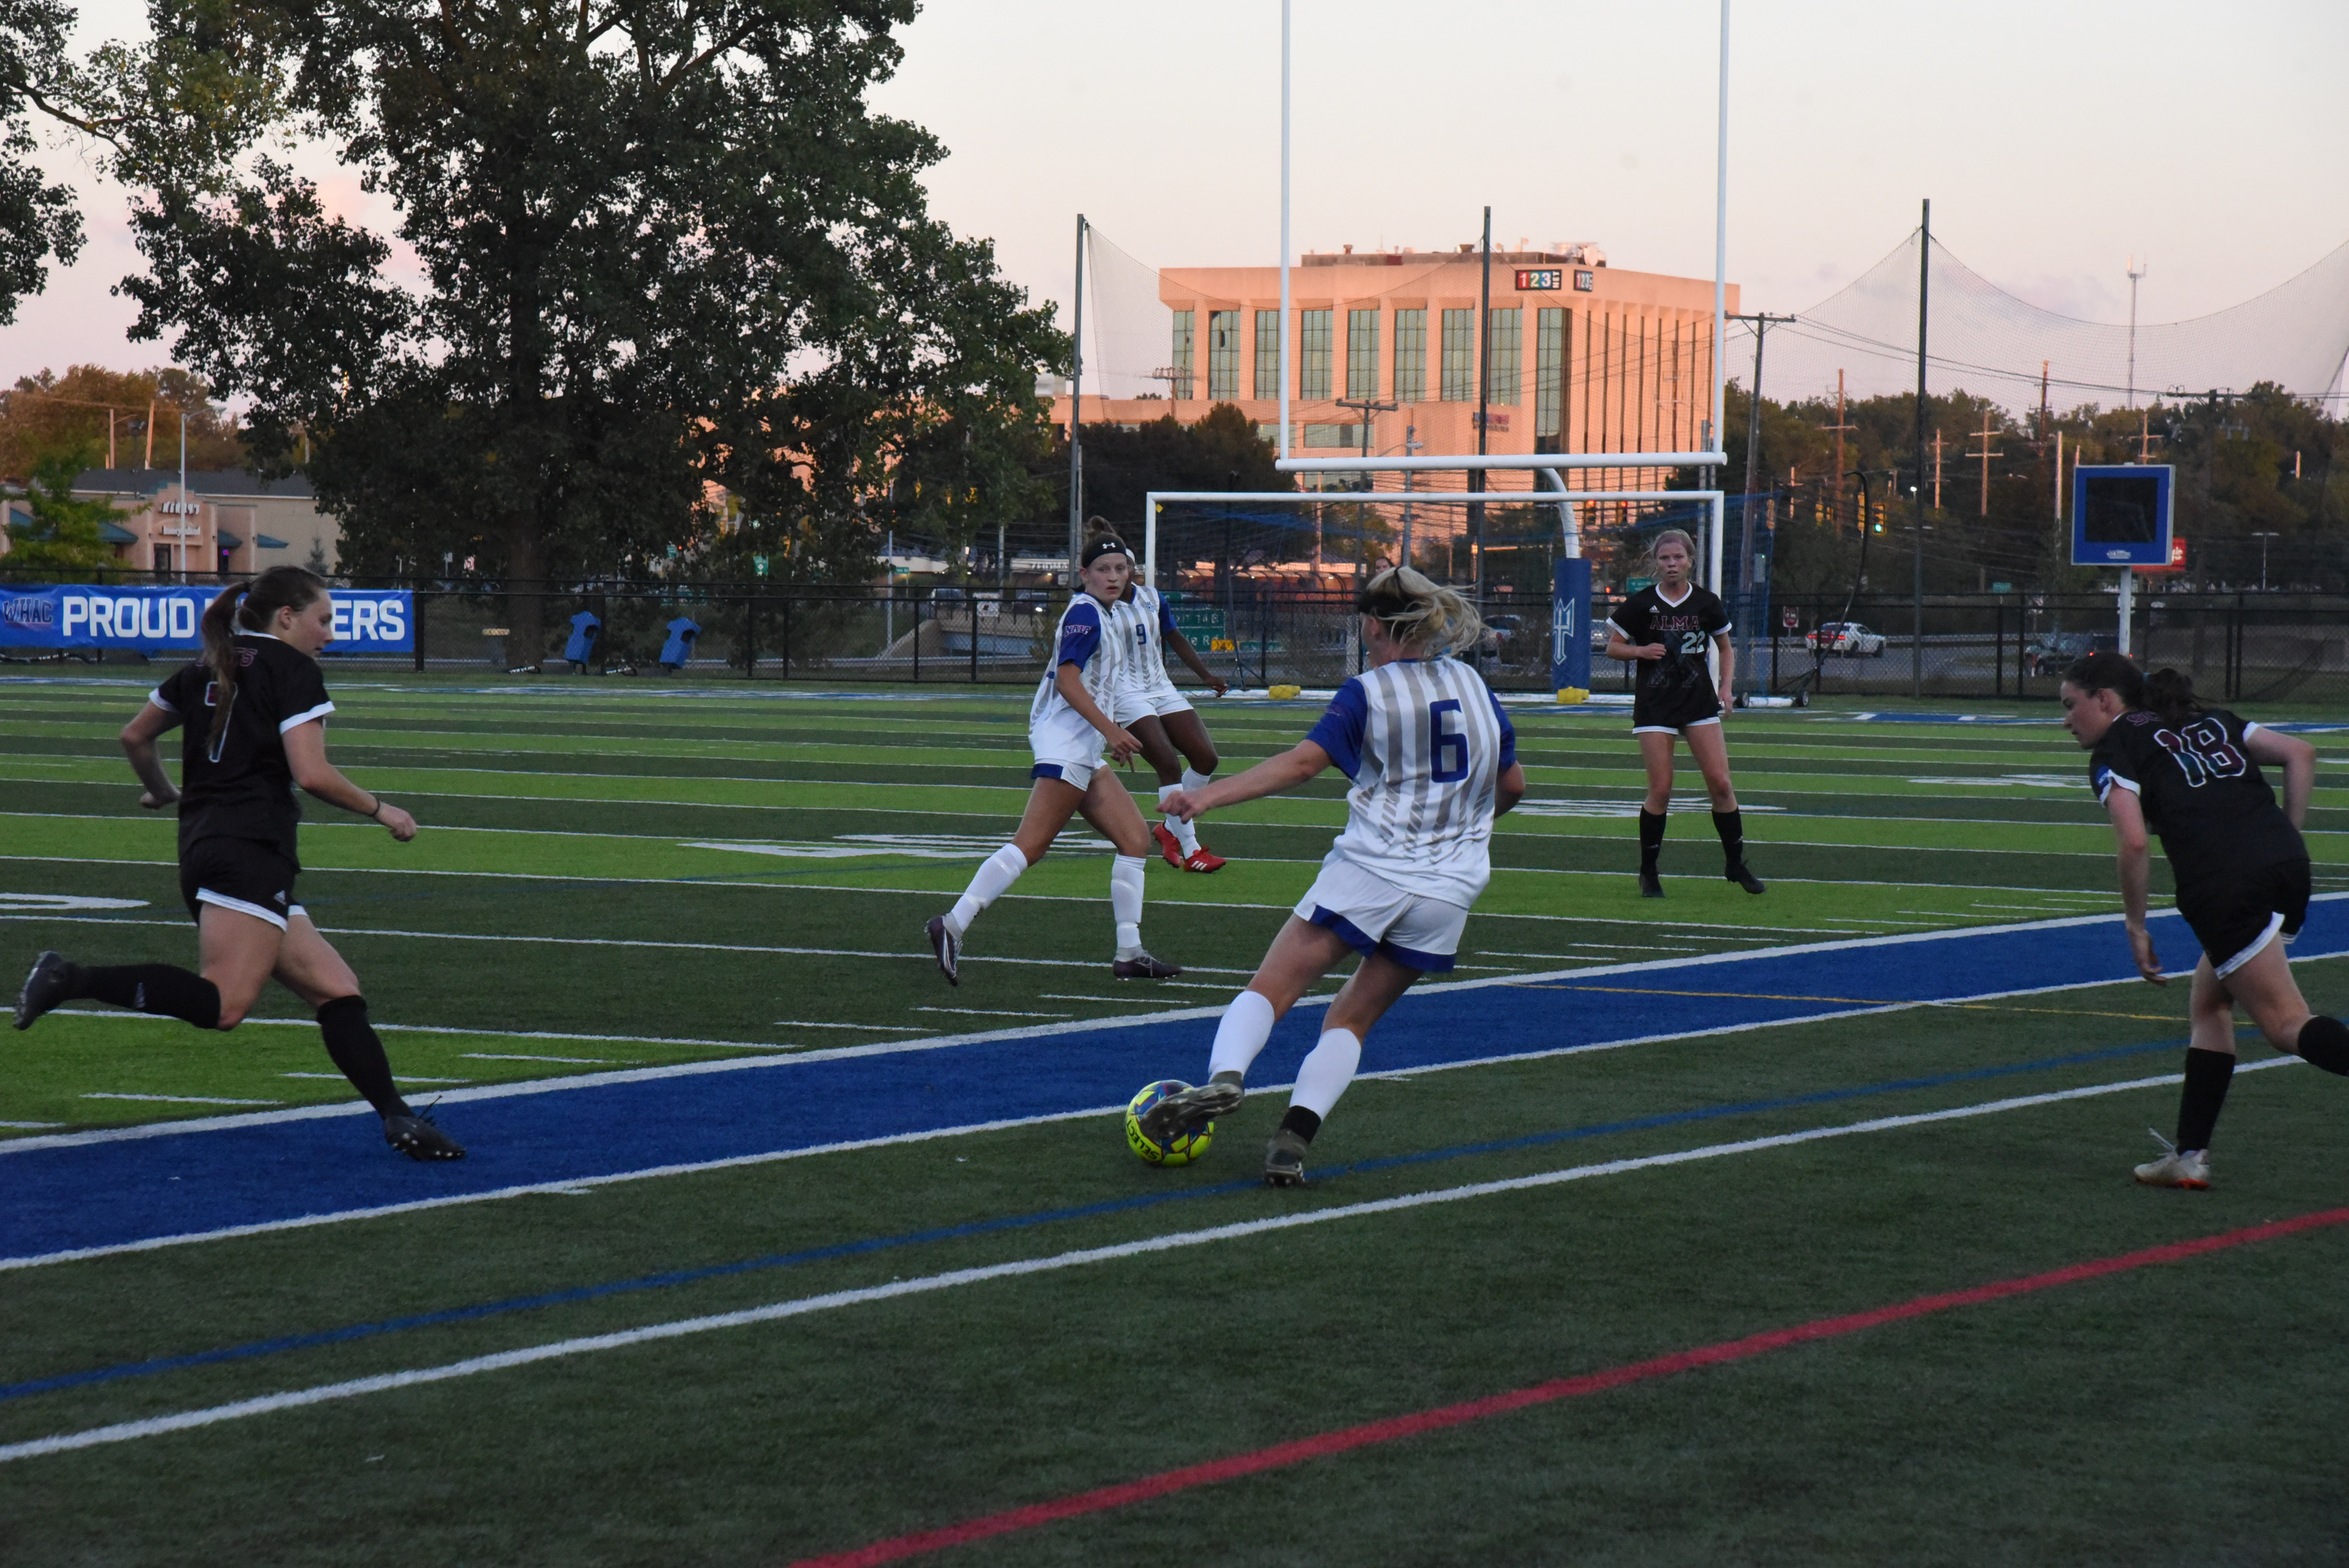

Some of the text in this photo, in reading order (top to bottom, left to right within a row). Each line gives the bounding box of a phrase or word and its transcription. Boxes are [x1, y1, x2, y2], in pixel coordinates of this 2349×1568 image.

[2, 597, 53, 624] WHAC
[62, 596, 196, 639] PROUD
[1650, 615, 1700, 631] ALMA
[1135, 623, 1147, 645] 9
[1680, 630, 1706, 654] 22
[1429, 698, 1469, 783] 6
[2153, 717, 2246, 788] 18
